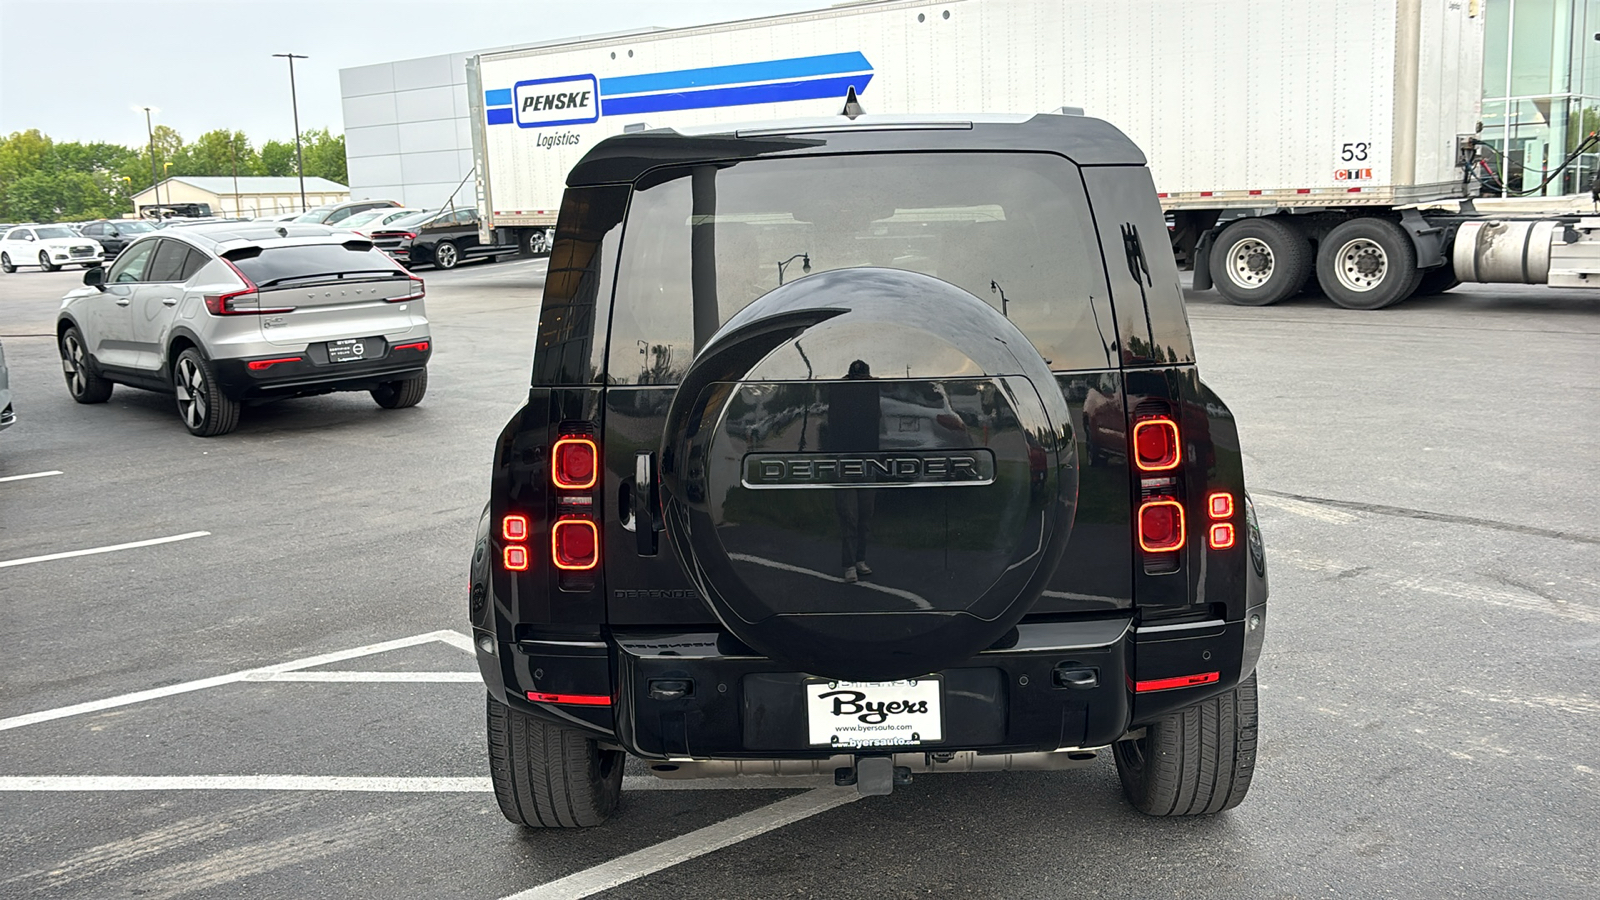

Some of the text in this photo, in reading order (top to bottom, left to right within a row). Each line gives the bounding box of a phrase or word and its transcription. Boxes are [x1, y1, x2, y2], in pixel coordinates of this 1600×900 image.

[522, 91, 591, 113] PENSKE
[536, 131, 580, 150] Logistics
[1335, 168, 1372, 180] CTL
[760, 457, 982, 479] DEFENDER
[614, 589, 698, 599] DEFENDE
[818, 690, 928, 724] Byers
[835, 724, 912, 733] www.byersauto.com
[832, 738, 921, 749] www.byersauto.com
